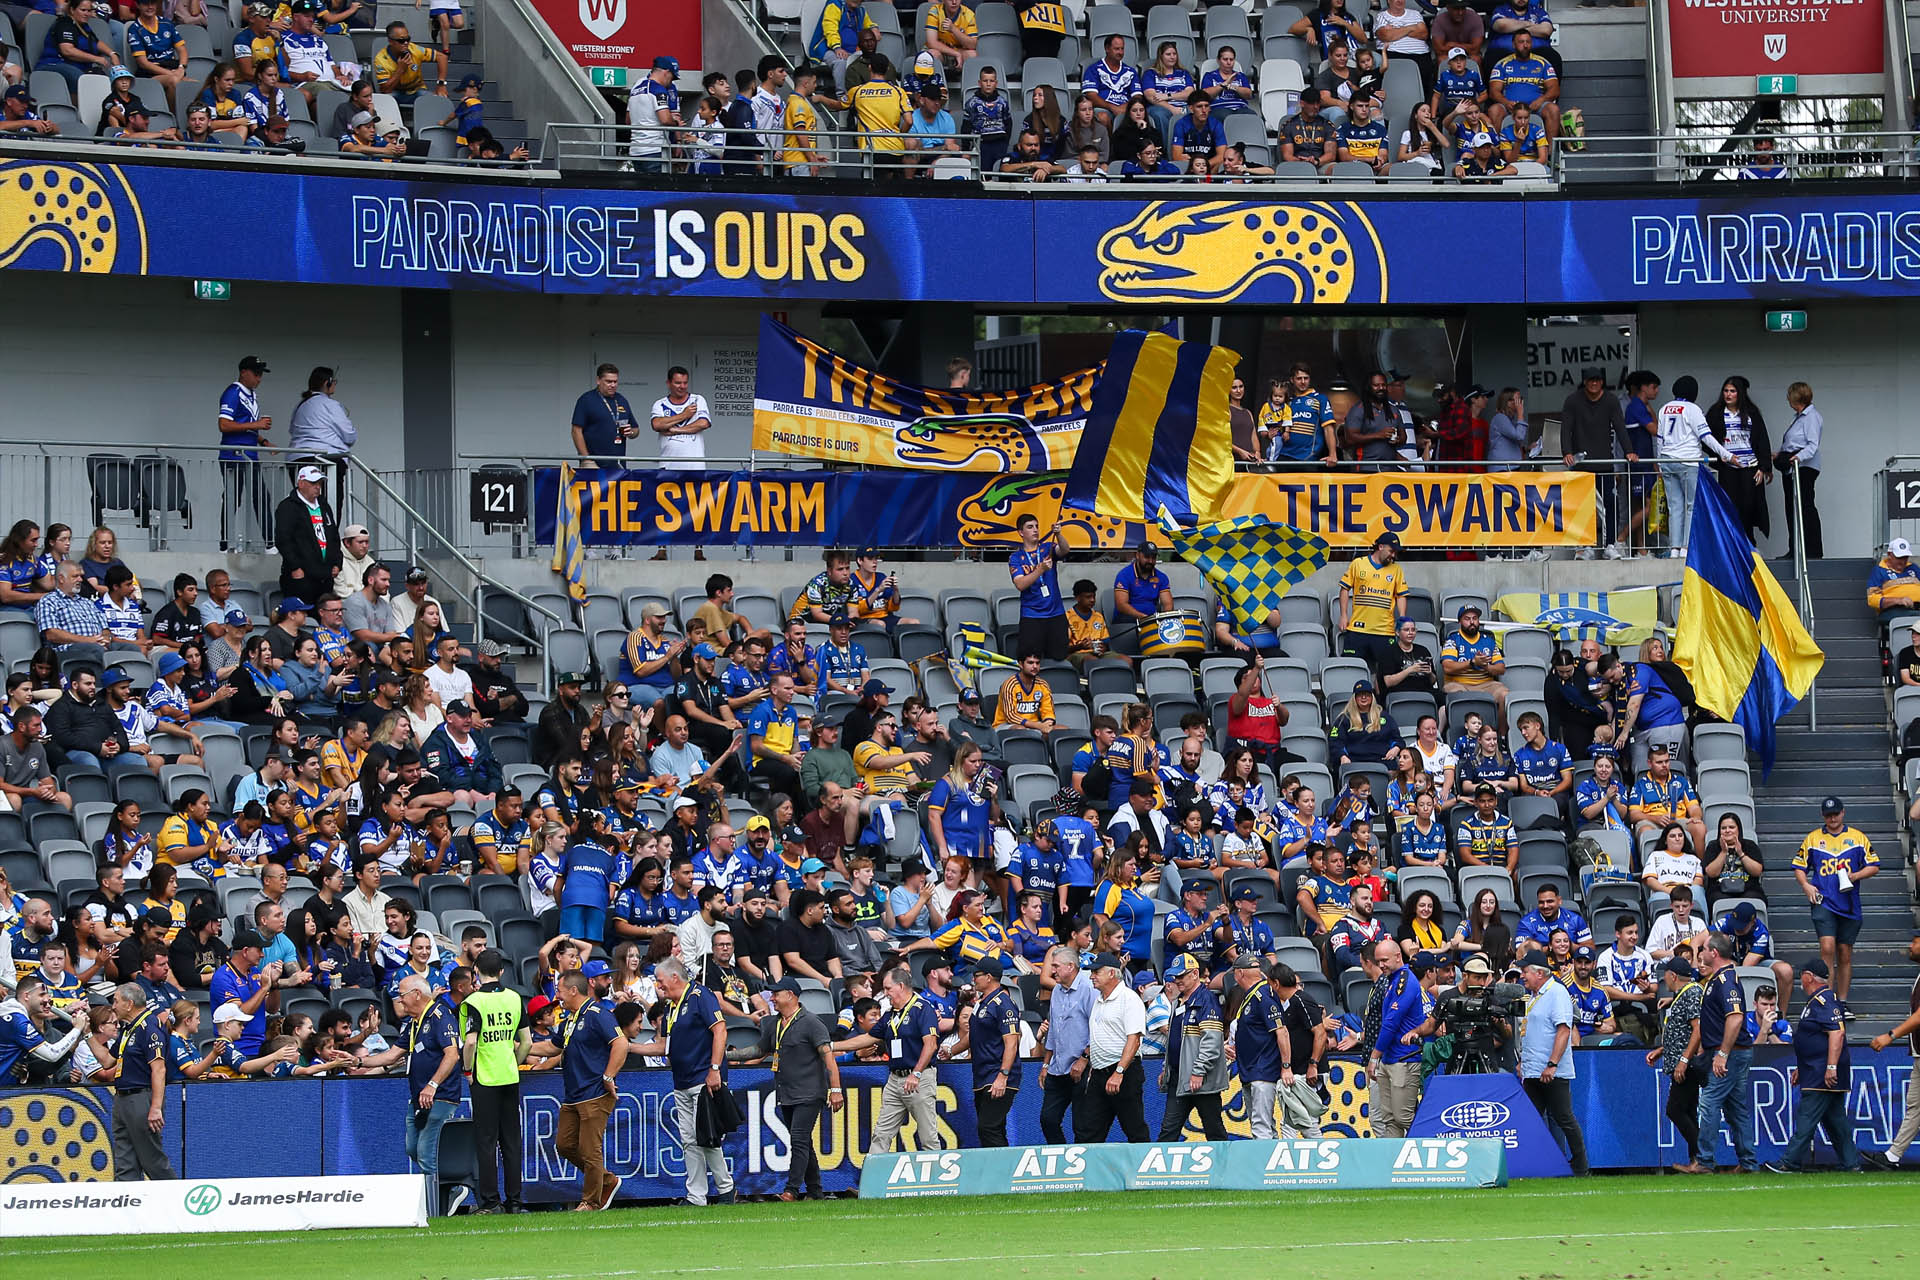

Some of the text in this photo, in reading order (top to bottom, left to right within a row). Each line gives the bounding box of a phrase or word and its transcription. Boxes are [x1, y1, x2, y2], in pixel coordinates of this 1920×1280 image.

[1720, 8, 1829, 24] UNIVERSITY
[572, 44, 635, 54] WESTERN SYDNEY
[1766, 38, 1784, 53] W
[584, 52, 622, 60] UNIVERSITY
[860, 88, 892, 96] PIRTEK
[352, 196, 866, 282] PARRADISE IS OURS
[1561, 343, 1629, 364] MEANS
[795, 336, 903, 416] THE
[773, 403, 896, 429] PARRA EELS PARRA EELS PARRA EELS
[1063, 421, 1082, 431] EELS
[1669, 417, 1676, 435] 7
[773, 431, 859, 452] PARRADISE IS OURS
[481, 483, 514, 513] 121
[571, 481, 825, 533] THE SWARM
[1279, 484, 1564, 533] THE SWARM
[1367, 585, 1390, 595] Hardie
[1069, 838, 1081, 856] 7
[748, 1091, 792, 1173] IS
[1465, 1129, 1500, 1138] WORLD
[1012, 1146, 1088, 1178] ATS
[1137, 1146, 1214, 1173] ATS
[1264, 1140, 1342, 1171] ATS
[1392, 1139, 1470, 1170] ATS
[887, 1152, 962, 1184] ATS
[885, 1191, 918, 1199] BUILDING
[1011, 1184, 1044, 1192] BUILDING
[3, 1194, 142, 1210] JamesHardie
[228, 1190, 365, 1206] JamesHardie
